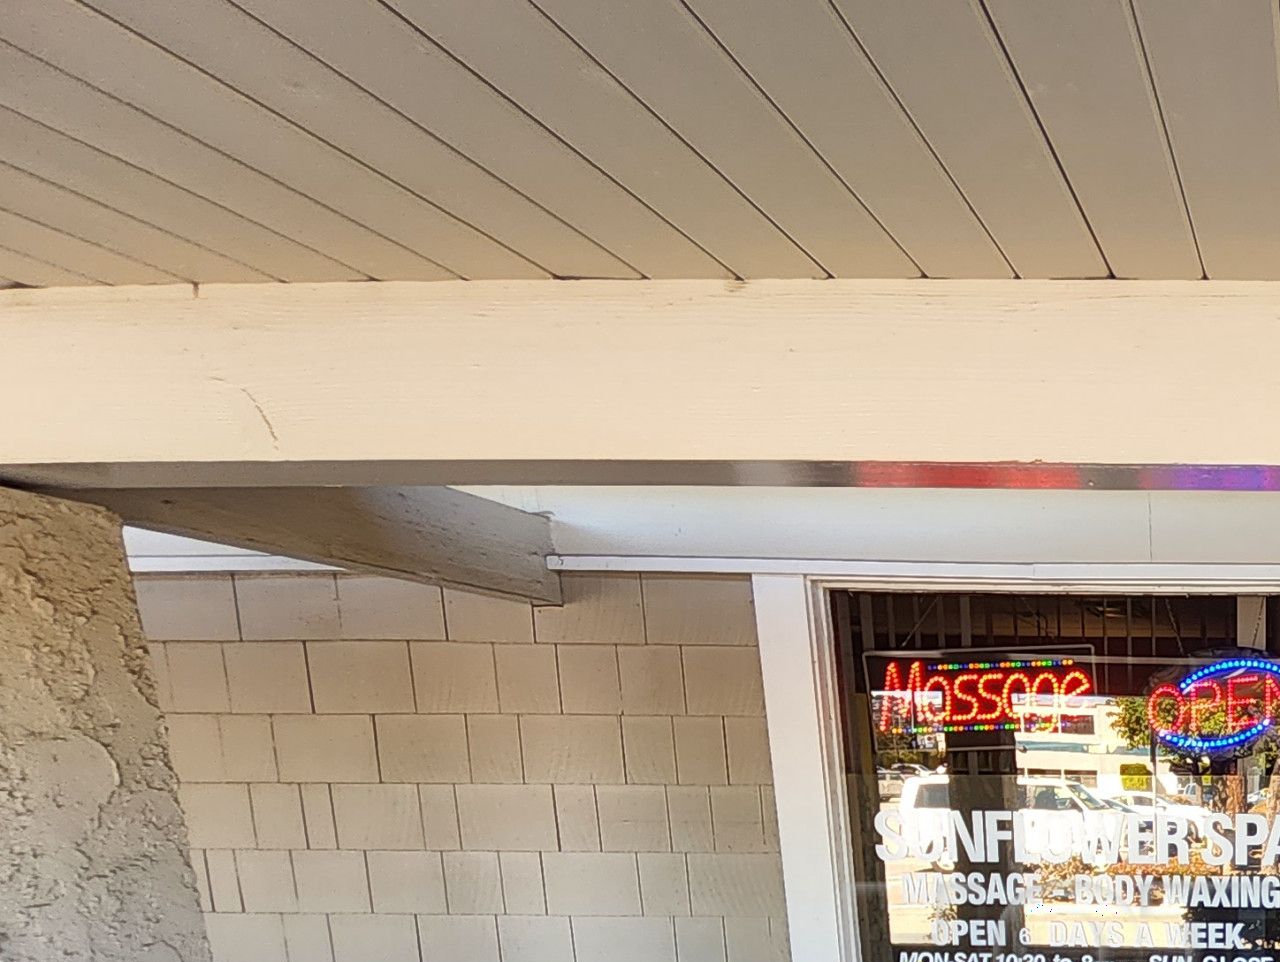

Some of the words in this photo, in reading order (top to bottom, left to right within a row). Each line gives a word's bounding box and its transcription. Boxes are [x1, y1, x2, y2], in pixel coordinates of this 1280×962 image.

[877, 661, 1091, 732] Massage
[874, 808, 1190, 866] SUNFLOWER
[902, 872, 1044, 906] MASSAGE
[1075, 874, 1154, 907] BODY
[1162, 875, 1280, 909] WAXING
[930, 919, 1007, 947] OPEN
[1019, 928, 1031, 946] 6
[1050, 920, 1125, 948] DAYS
[1133, 921, 1155, 948] A
[1165, 922, 1246, 950] WEEK
